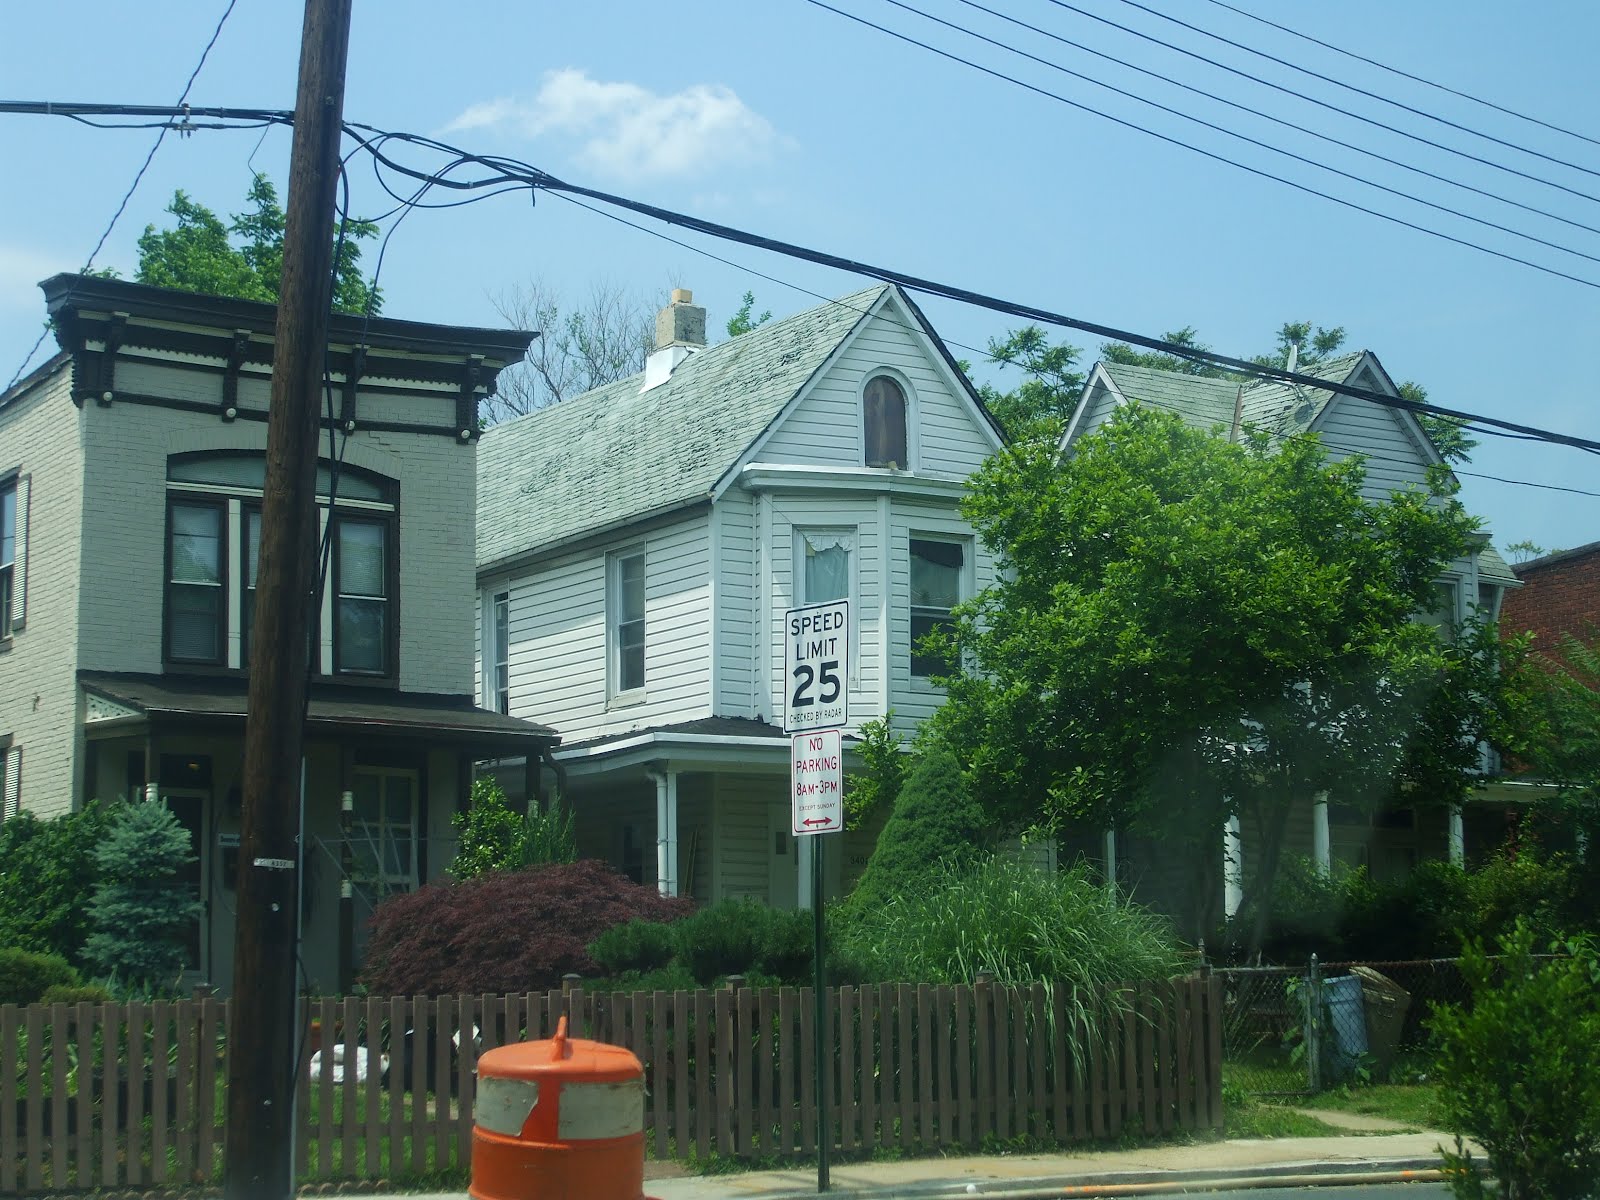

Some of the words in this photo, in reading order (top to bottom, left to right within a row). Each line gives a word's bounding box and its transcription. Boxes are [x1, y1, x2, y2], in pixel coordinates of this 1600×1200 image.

[790, 611, 844, 637] SPEED
[796, 637, 838, 661] LIMIT
[791, 660, 841, 708] 25
[789, 711, 814, 724] CHECKED
[815, 710, 823, 721] BY
[824, 708, 842, 719] RADAR
[809, 737, 823, 752] NO
[796, 756, 837, 775] PARKING
[796, 780, 838, 797] 8AM-3PM
[799, 804, 816, 812] EXCEPT
[817, 802, 836, 810] SUNDAY
